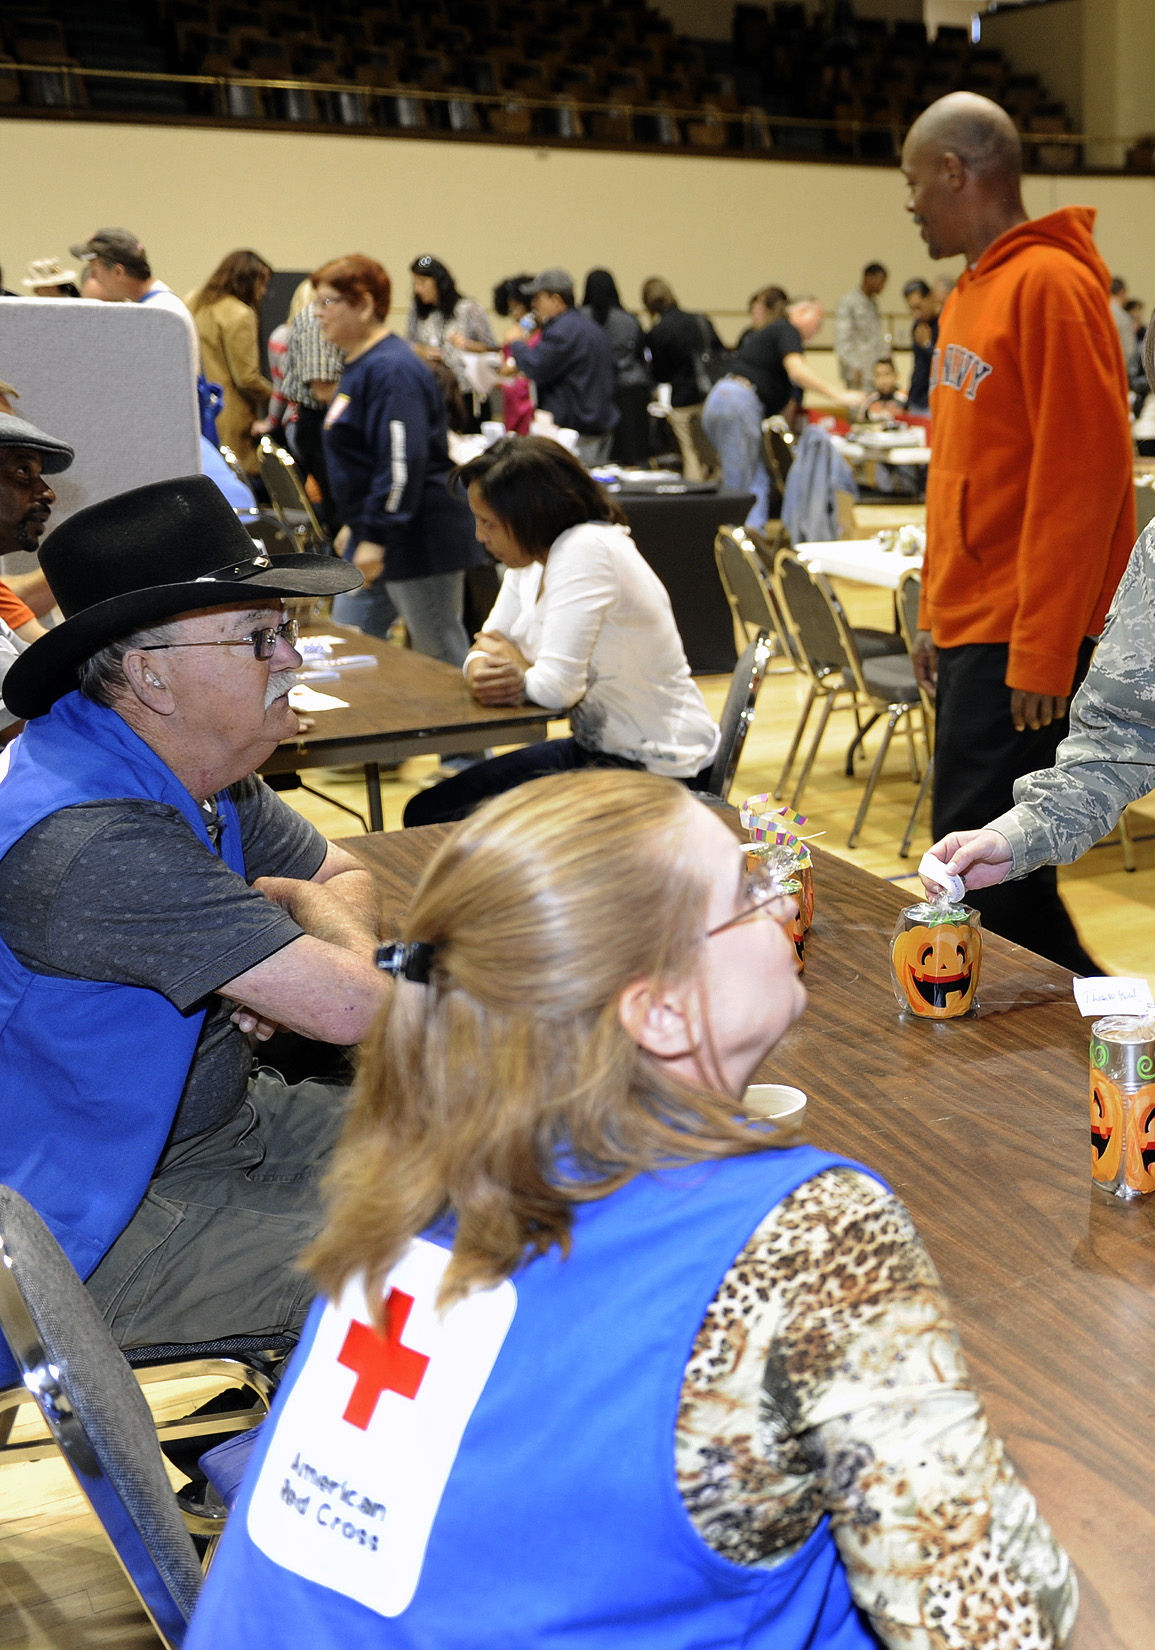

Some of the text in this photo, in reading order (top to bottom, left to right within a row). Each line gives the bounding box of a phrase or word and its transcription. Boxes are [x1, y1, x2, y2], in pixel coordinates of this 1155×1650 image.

[941, 343, 993, 401] NAVY
[290, 1451, 387, 1522] American
[316, 1502, 380, 1553] Cross
